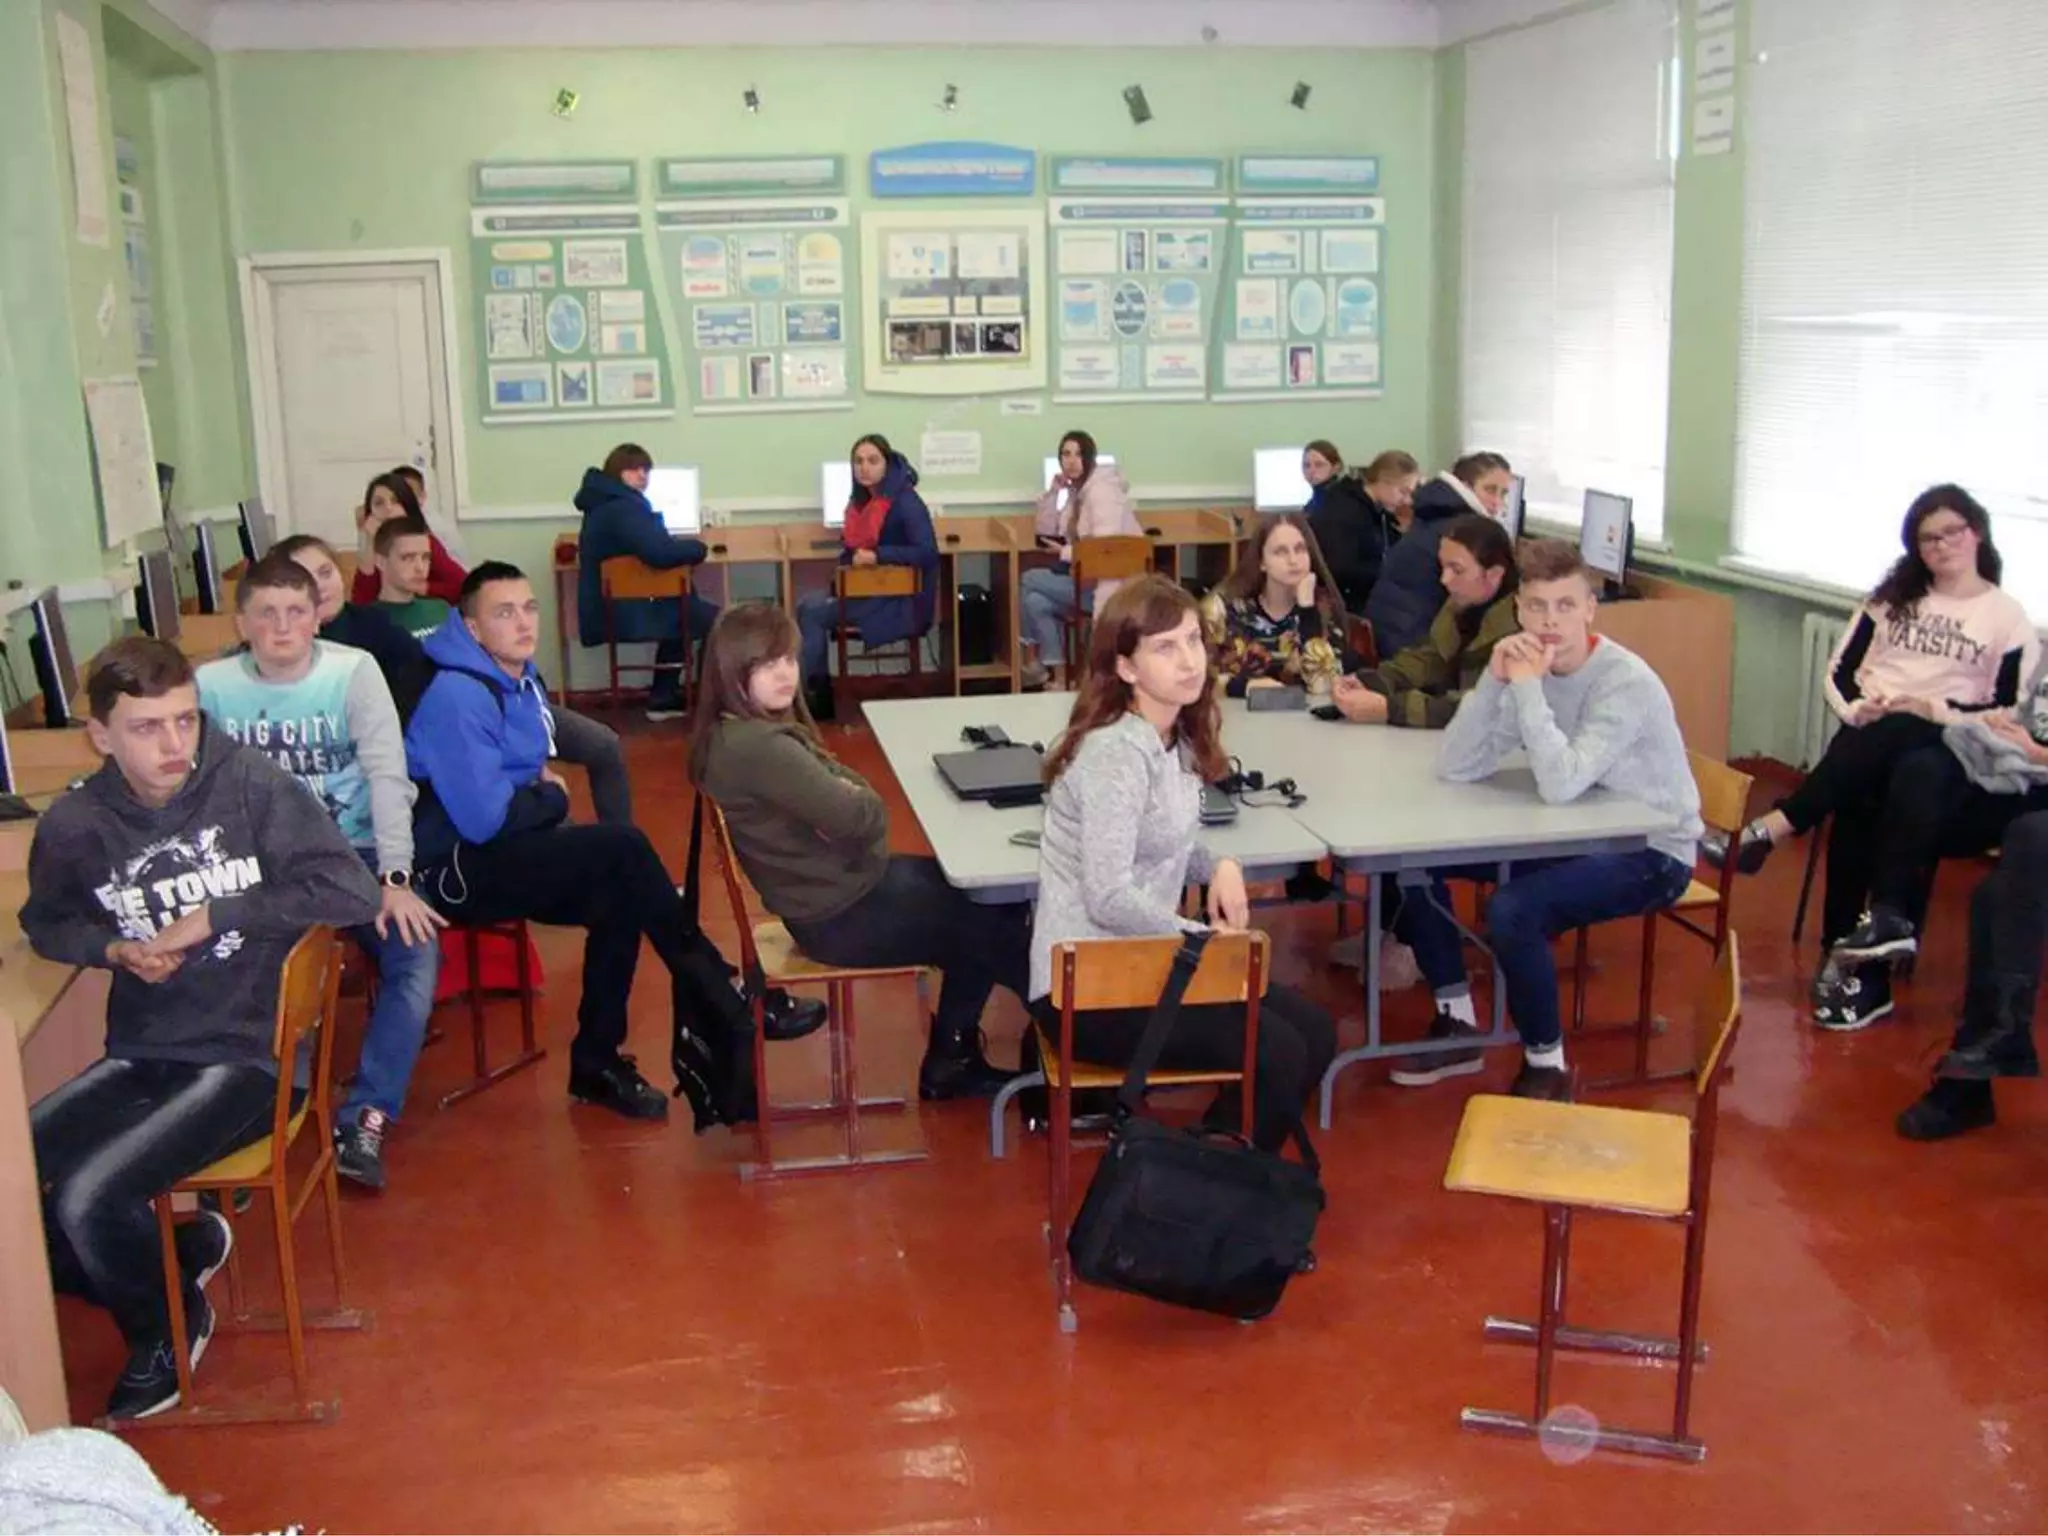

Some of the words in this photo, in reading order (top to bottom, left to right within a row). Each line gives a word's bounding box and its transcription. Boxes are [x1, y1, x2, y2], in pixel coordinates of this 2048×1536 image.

[1887, 619, 1987, 665] VARSITY
[226, 717, 271, 746] BIG
[281, 710, 338, 745] CITY
[152, 856, 262, 909] TOWN
